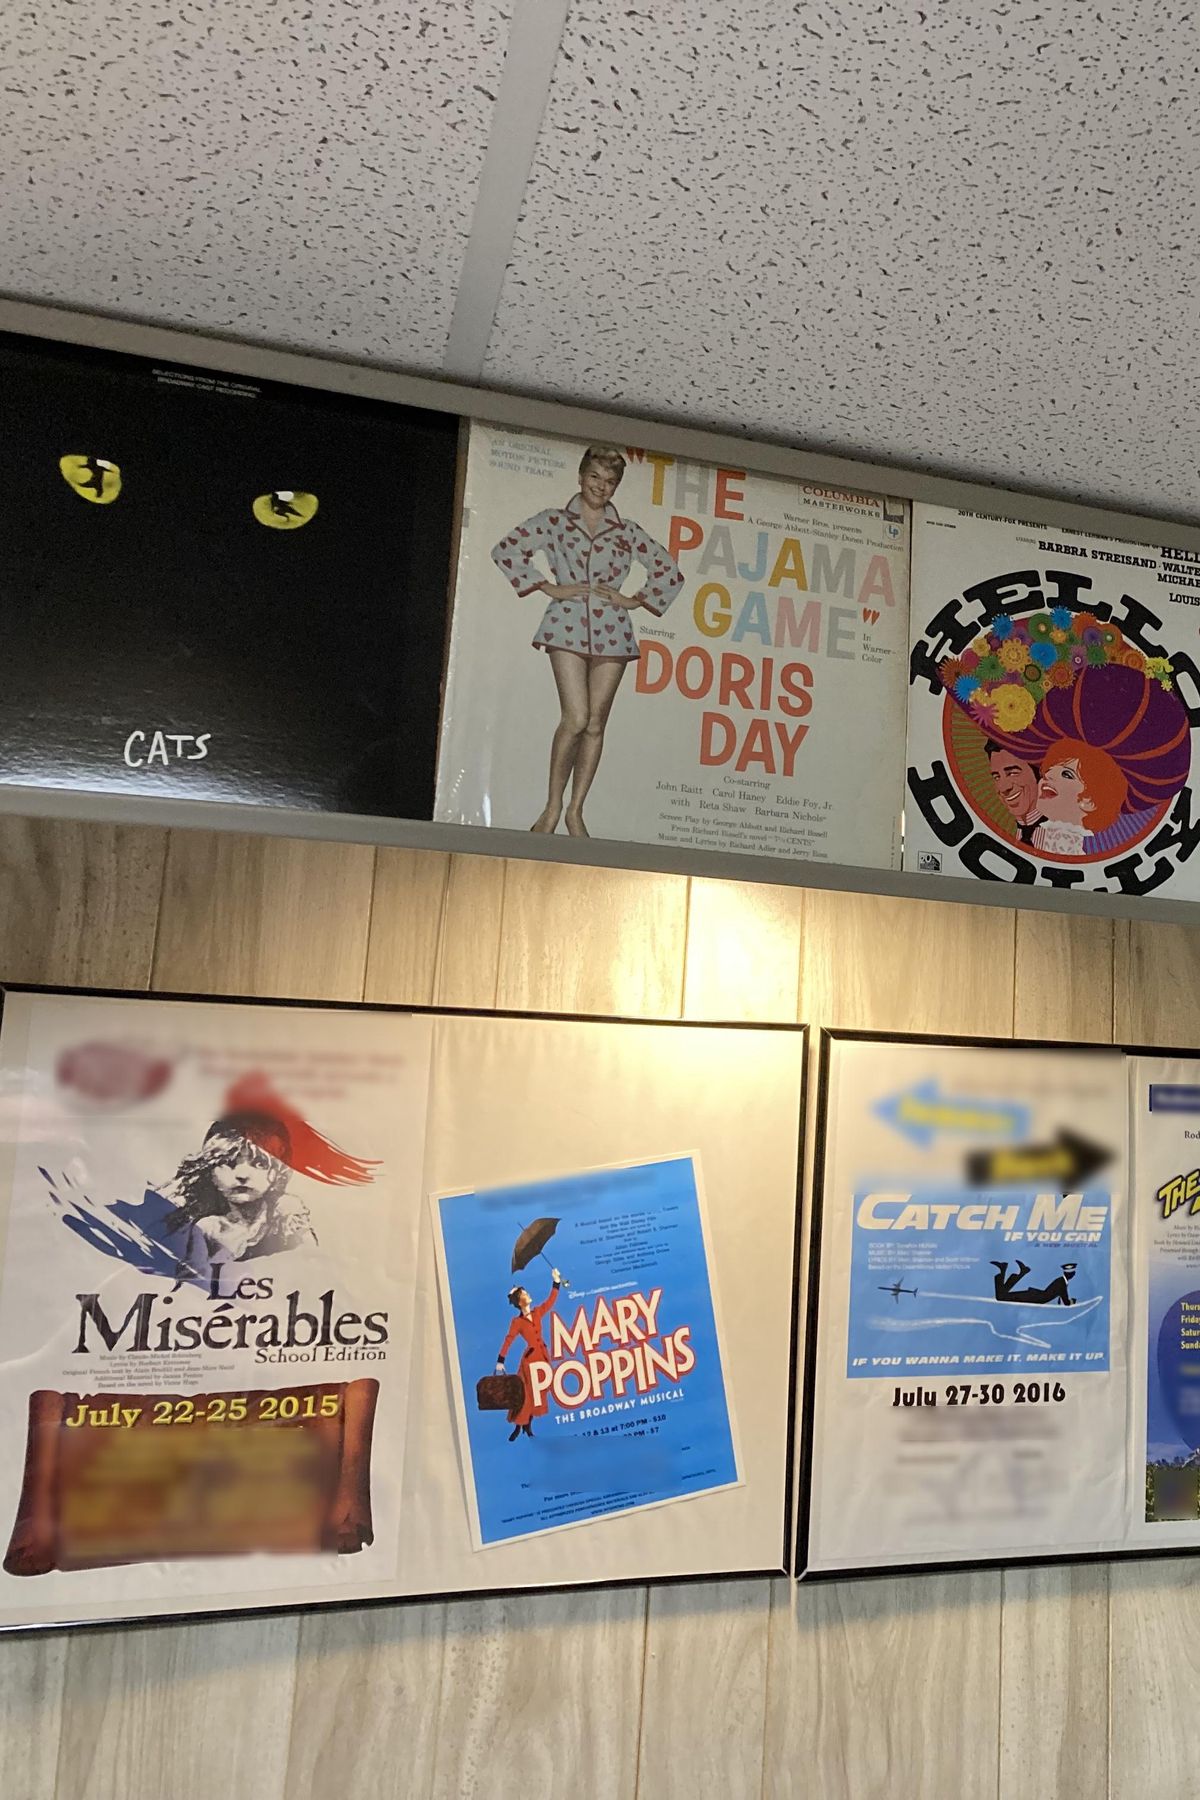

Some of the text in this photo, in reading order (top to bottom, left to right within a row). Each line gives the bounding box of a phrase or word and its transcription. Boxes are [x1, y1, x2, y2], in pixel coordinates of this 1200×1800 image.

[802, 485, 881, 508] COLUMBIA
[803, 497, 881, 518] MASTERWORKS
[958, 509, 974, 518] 20TH
[1018, 520, 1048, 530] PRESENTS
[668, 515, 896, 607] PAJAMA
[1038, 540, 1088, 558] BARBRA
[1091, 550, 1156, 569] STREISAND
[1169, 592, 1200, 606] LOUIS
[640, 625, 676, 640] Starring
[693, 582, 857, 661] GAME
[635, 639, 815, 718] DORIS
[124, 730, 211, 767] CATS
[699, 711, 811, 778] DAY
[656, 781, 677, 792] John
[681, 784, 702, 795] Raitt
[712, 788, 736, 799] Carol
[739, 791, 766, 804] Haney
[776, 795, 800, 806] Eddie
[723, 776, 771, 790] Co-starring
[670, 798, 690, 808] with
[700, 800, 720, 811] Reta
[722, 803, 747, 814] Shaw
[755, 807, 789, 819] Barbara
[1157, 1169, 1200, 1219] THE
[857, 1193, 1021, 1231] CATCH
[1004, 1231, 1102, 1242] IF YOU CAN
[206, 1262, 274, 1300] Les
[72, 1289, 390, 1354] Misérables
[551, 1289, 663, 1359] MARY
[254, 1346, 387, 1364] School Edition
[527, 1327, 696, 1408] POPPINS
[853, 1358, 868, 1366] IF
[872, 1357, 903, 1366] YOU
[905, 1355, 960, 1365] WANNA
[963, 1354, 1005, 1364] MAKE
[1026, 1353, 1066, 1362] MAKE
[1069, 1352, 1082, 1360] IT
[555, 1388, 684, 1425] THE BROADWAY MUSICAL
[893, 1382, 1066, 1407] July 27-30 2016
[66, 1394, 340, 1429] July 22-25 2015
[620, 1420, 635, 1430] 7:00
[636, 1418, 648, 1426] PM
